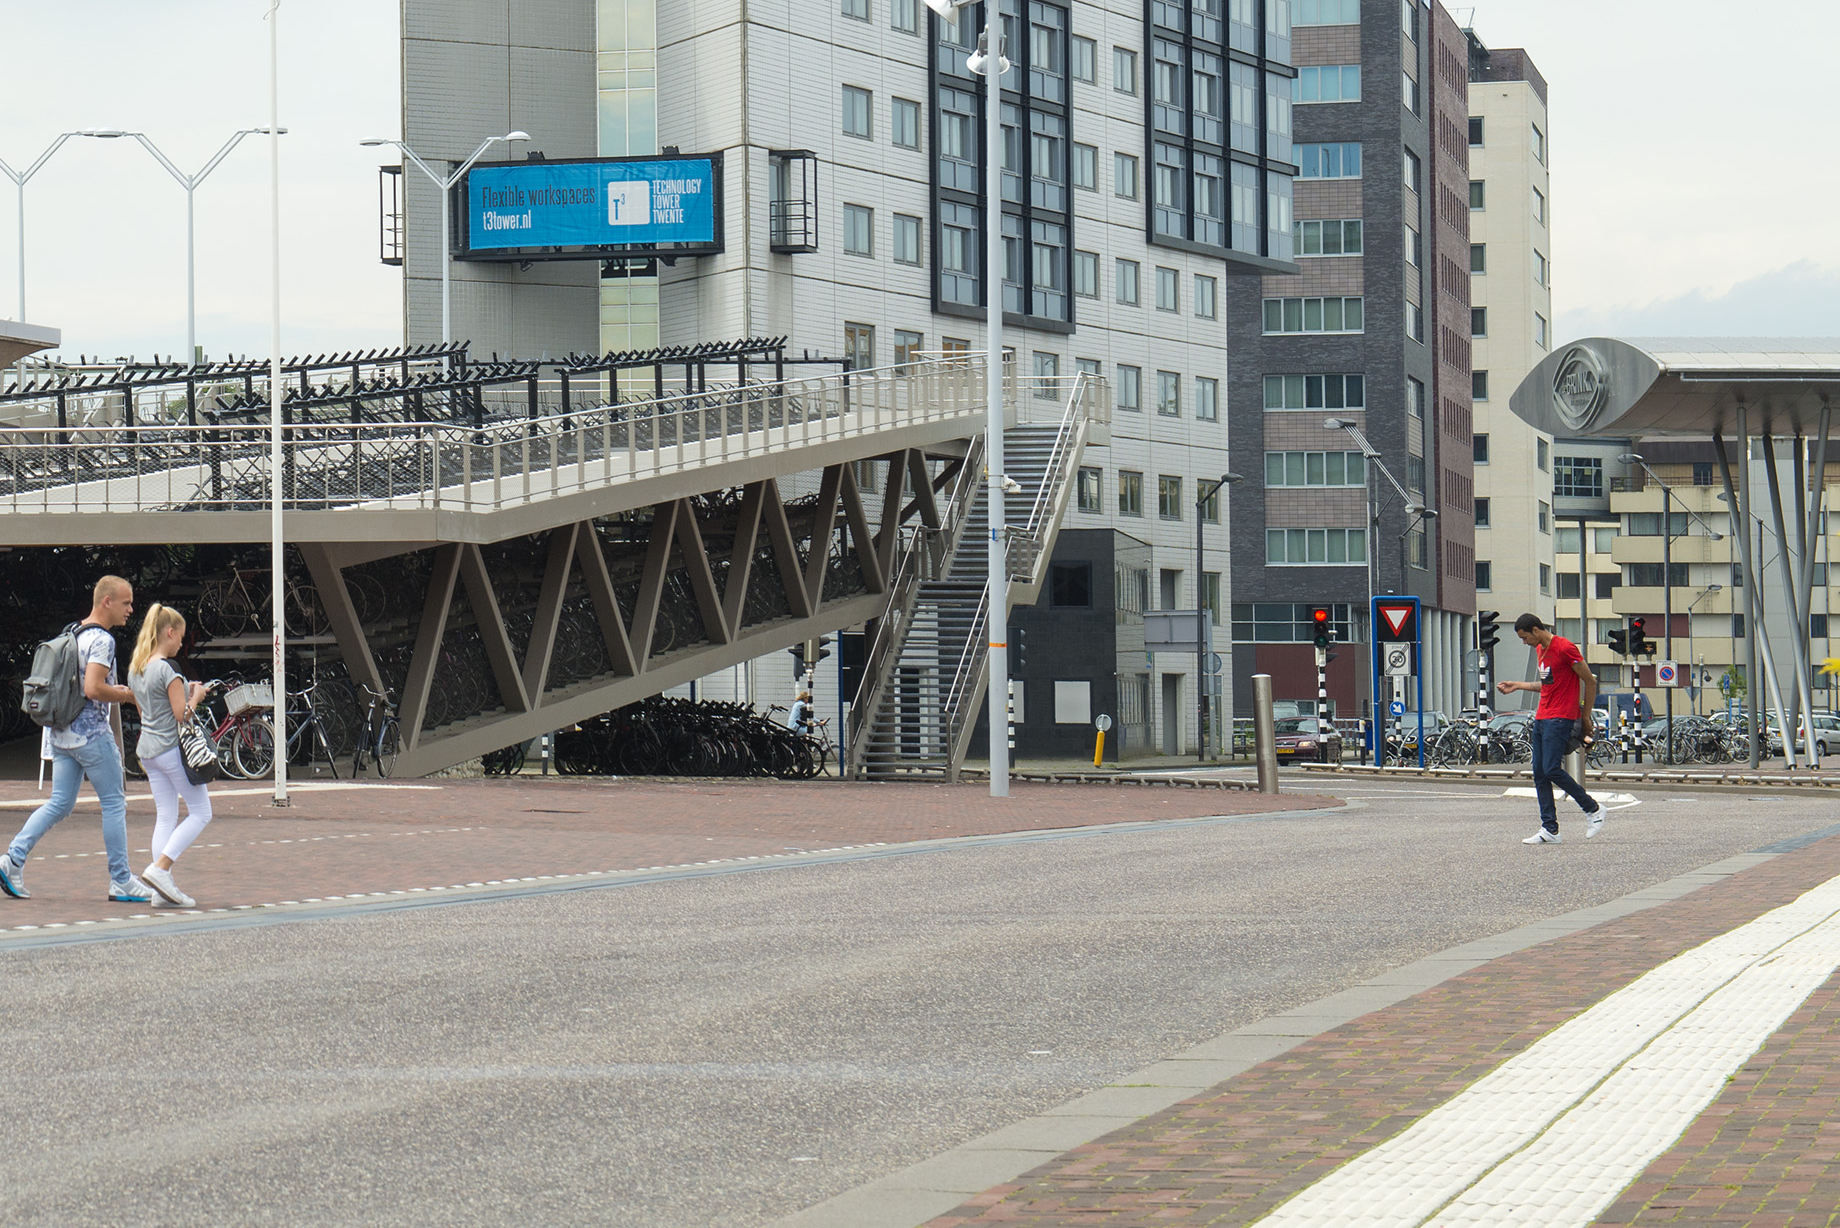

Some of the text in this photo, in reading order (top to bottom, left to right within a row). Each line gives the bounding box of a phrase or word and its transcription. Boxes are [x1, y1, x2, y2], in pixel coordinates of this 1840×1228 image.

[652, 178, 702, 194] TECHNOLOGY
[482, 183, 596, 208] Flexible workspaces
[652, 194, 680, 209] TOWER
[483, 209, 532, 231] t3tower.nl
[652, 208, 685, 224] TWENTE
[1392, 655, 1403, 664] 30
